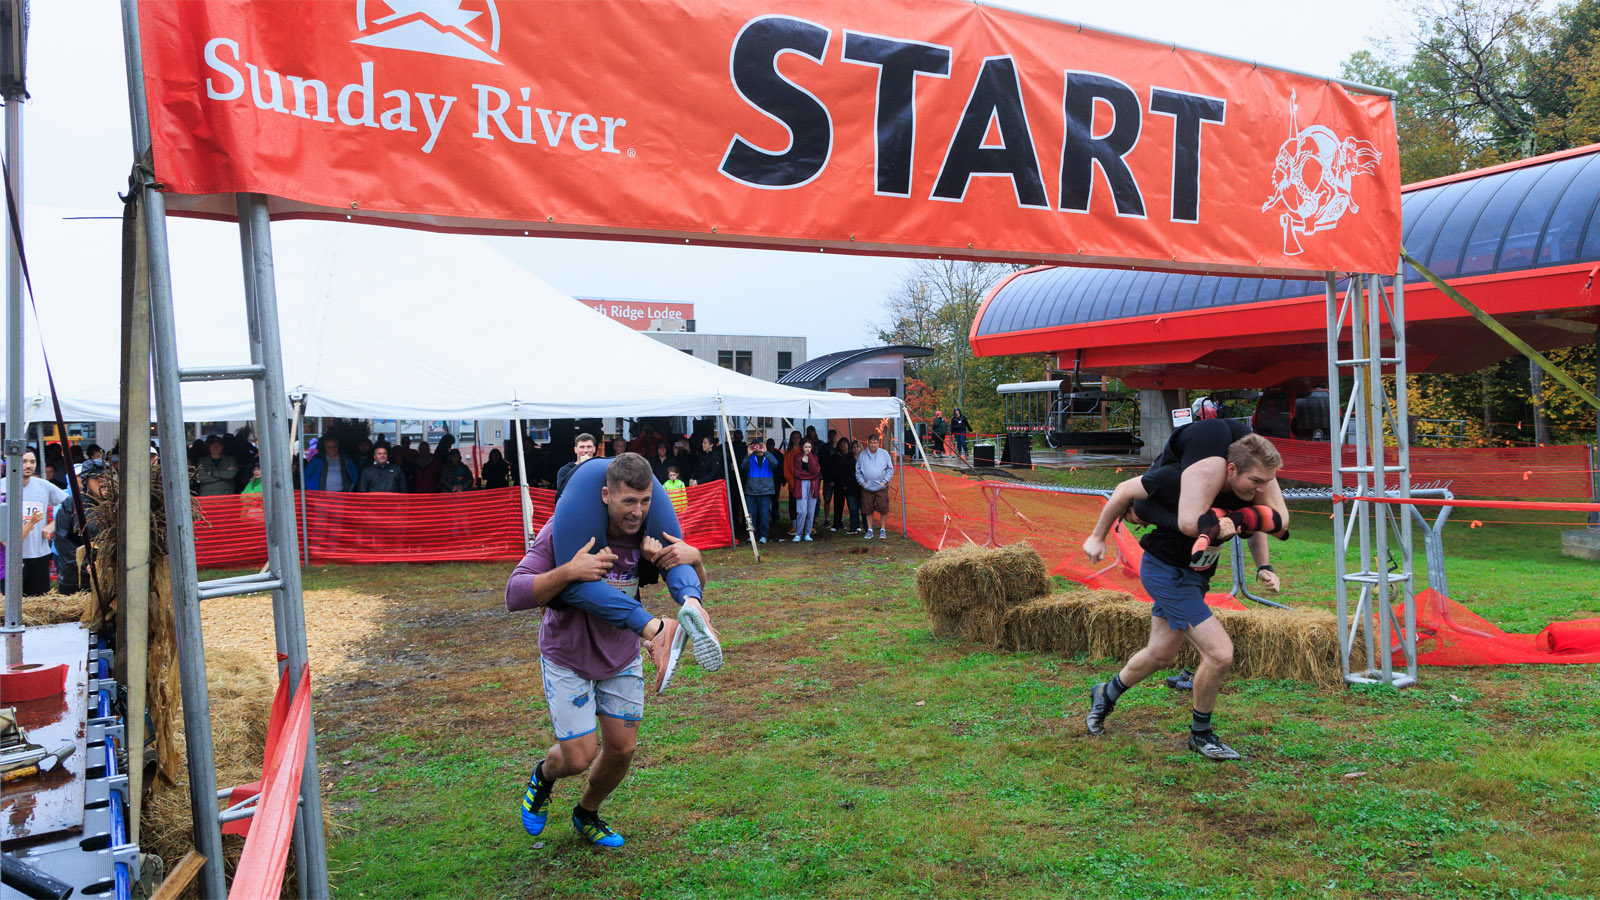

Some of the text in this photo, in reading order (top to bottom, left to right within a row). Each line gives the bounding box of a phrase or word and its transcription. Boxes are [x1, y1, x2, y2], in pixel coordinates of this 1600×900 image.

[204, 37, 627, 154] Sunday River
[717, 14, 1227, 224] START
[611, 305, 645, 321] Ridge
[648, 306, 682, 320] Lodge
